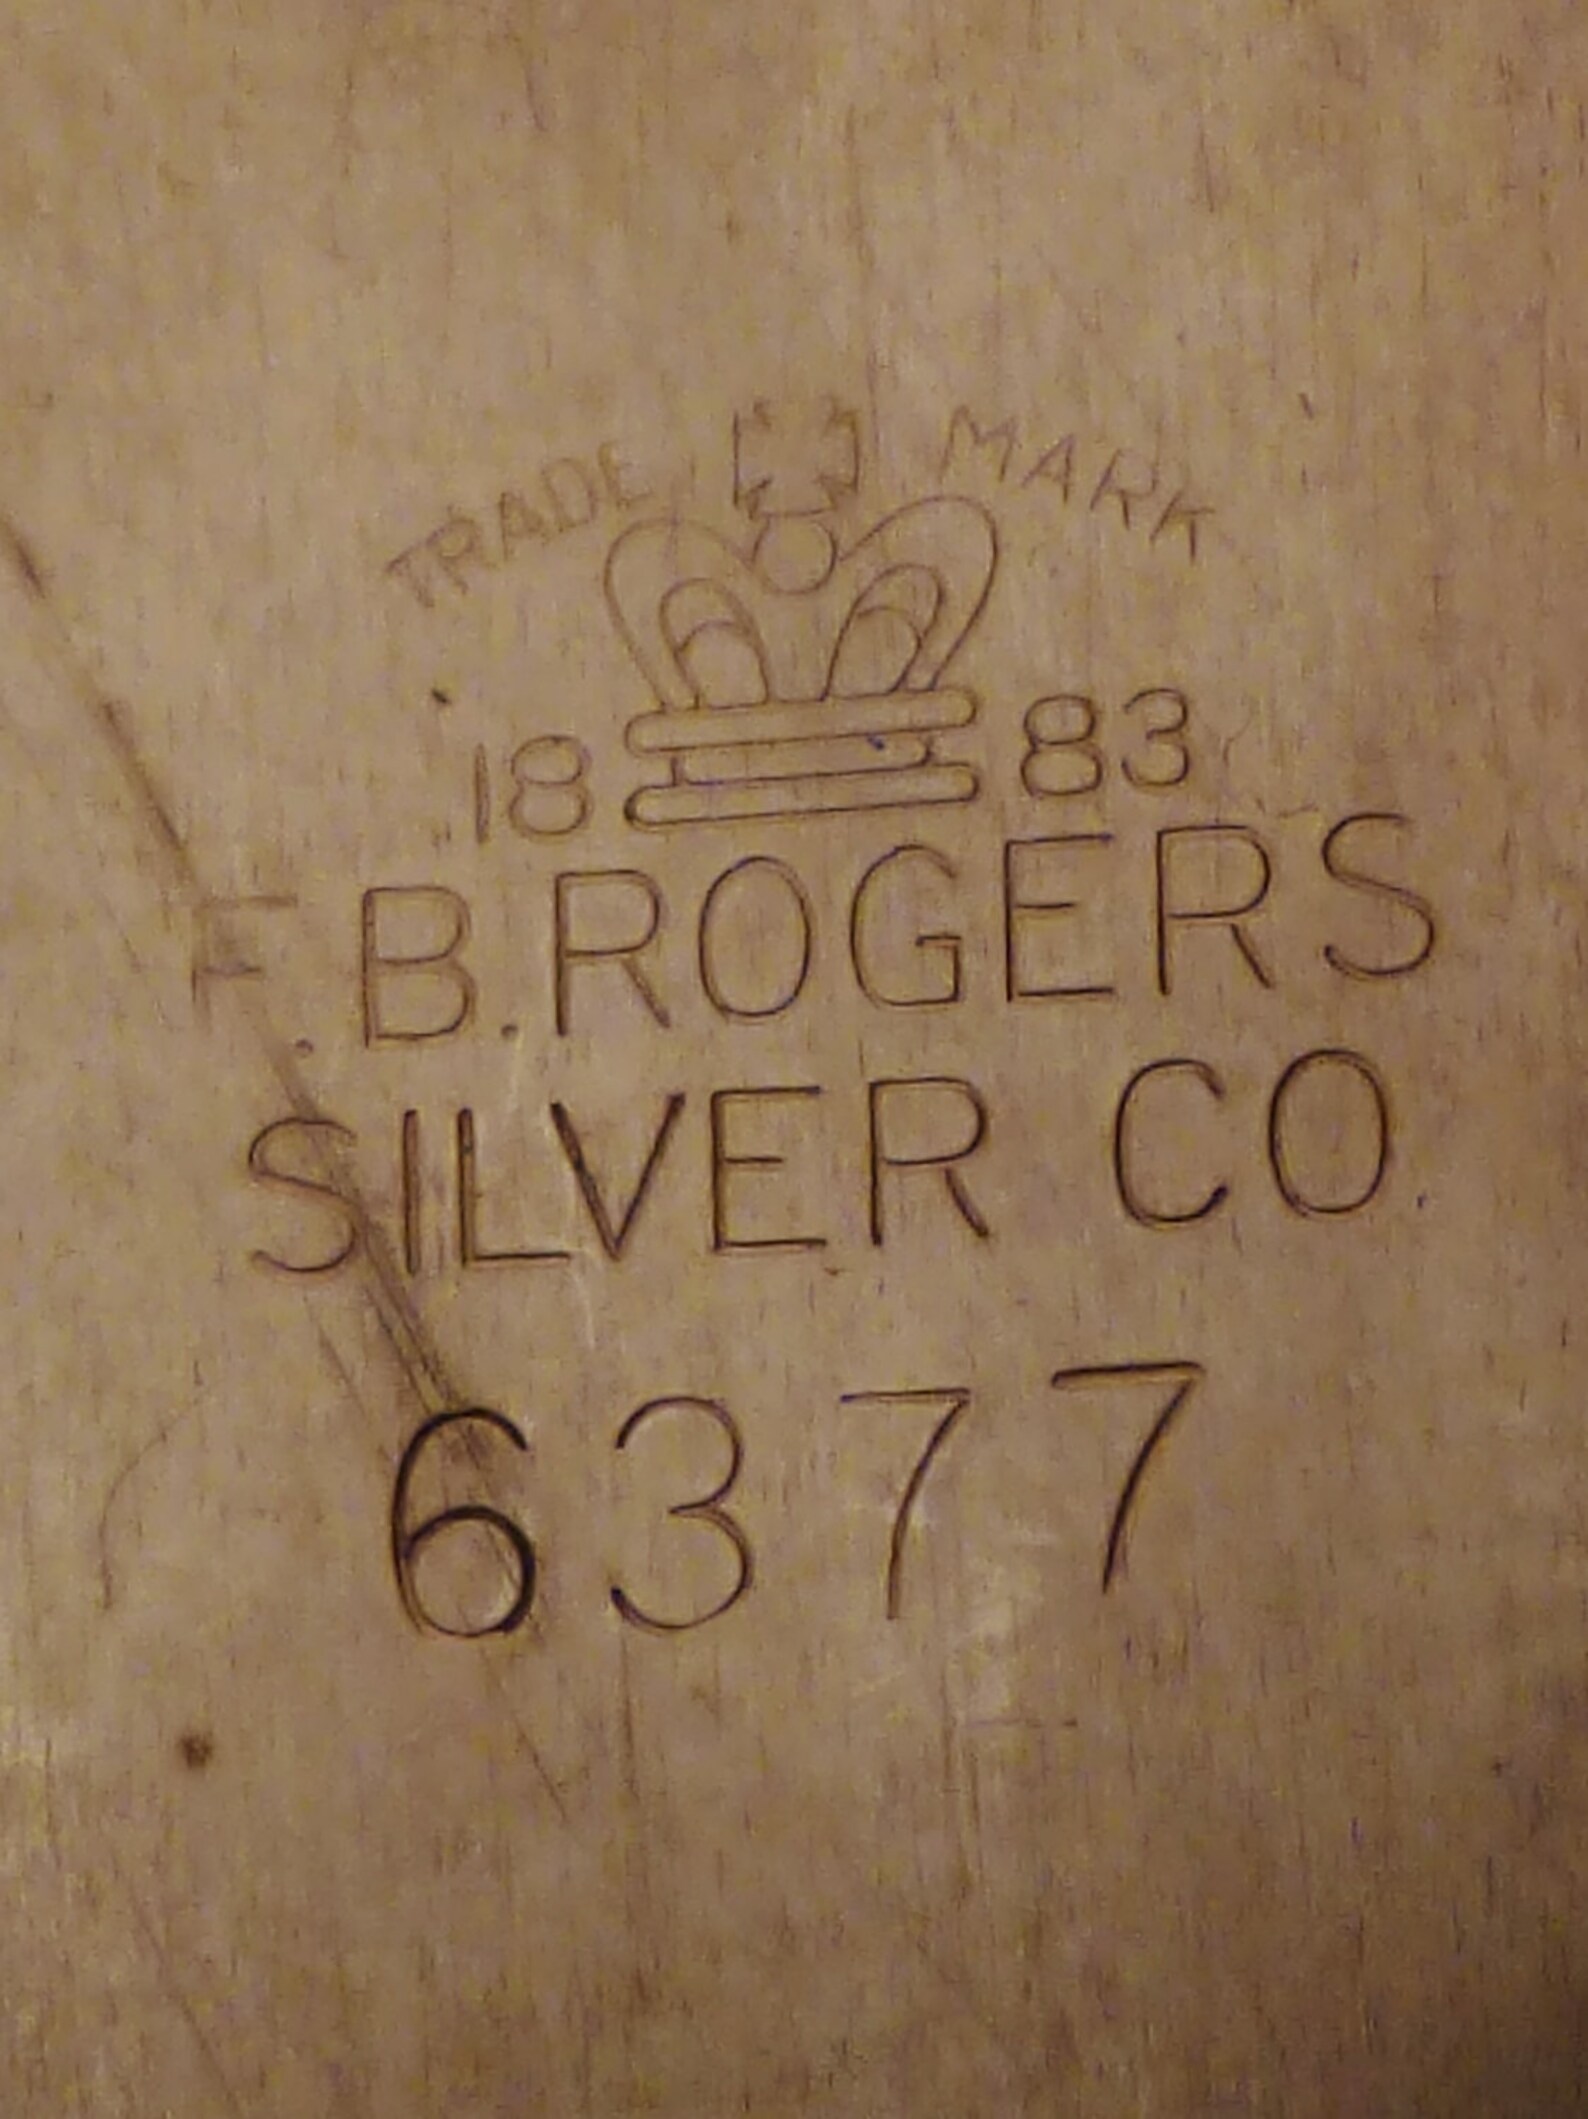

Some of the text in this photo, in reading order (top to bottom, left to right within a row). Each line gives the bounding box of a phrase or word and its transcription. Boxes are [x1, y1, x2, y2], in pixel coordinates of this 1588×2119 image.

[938, 404, 1214, 564] MARK
[474, 688, 1190, 844] 18 83
[249, 1076, 989, 1276] SILVER
[391, 1359, 1206, 1637] 6377
